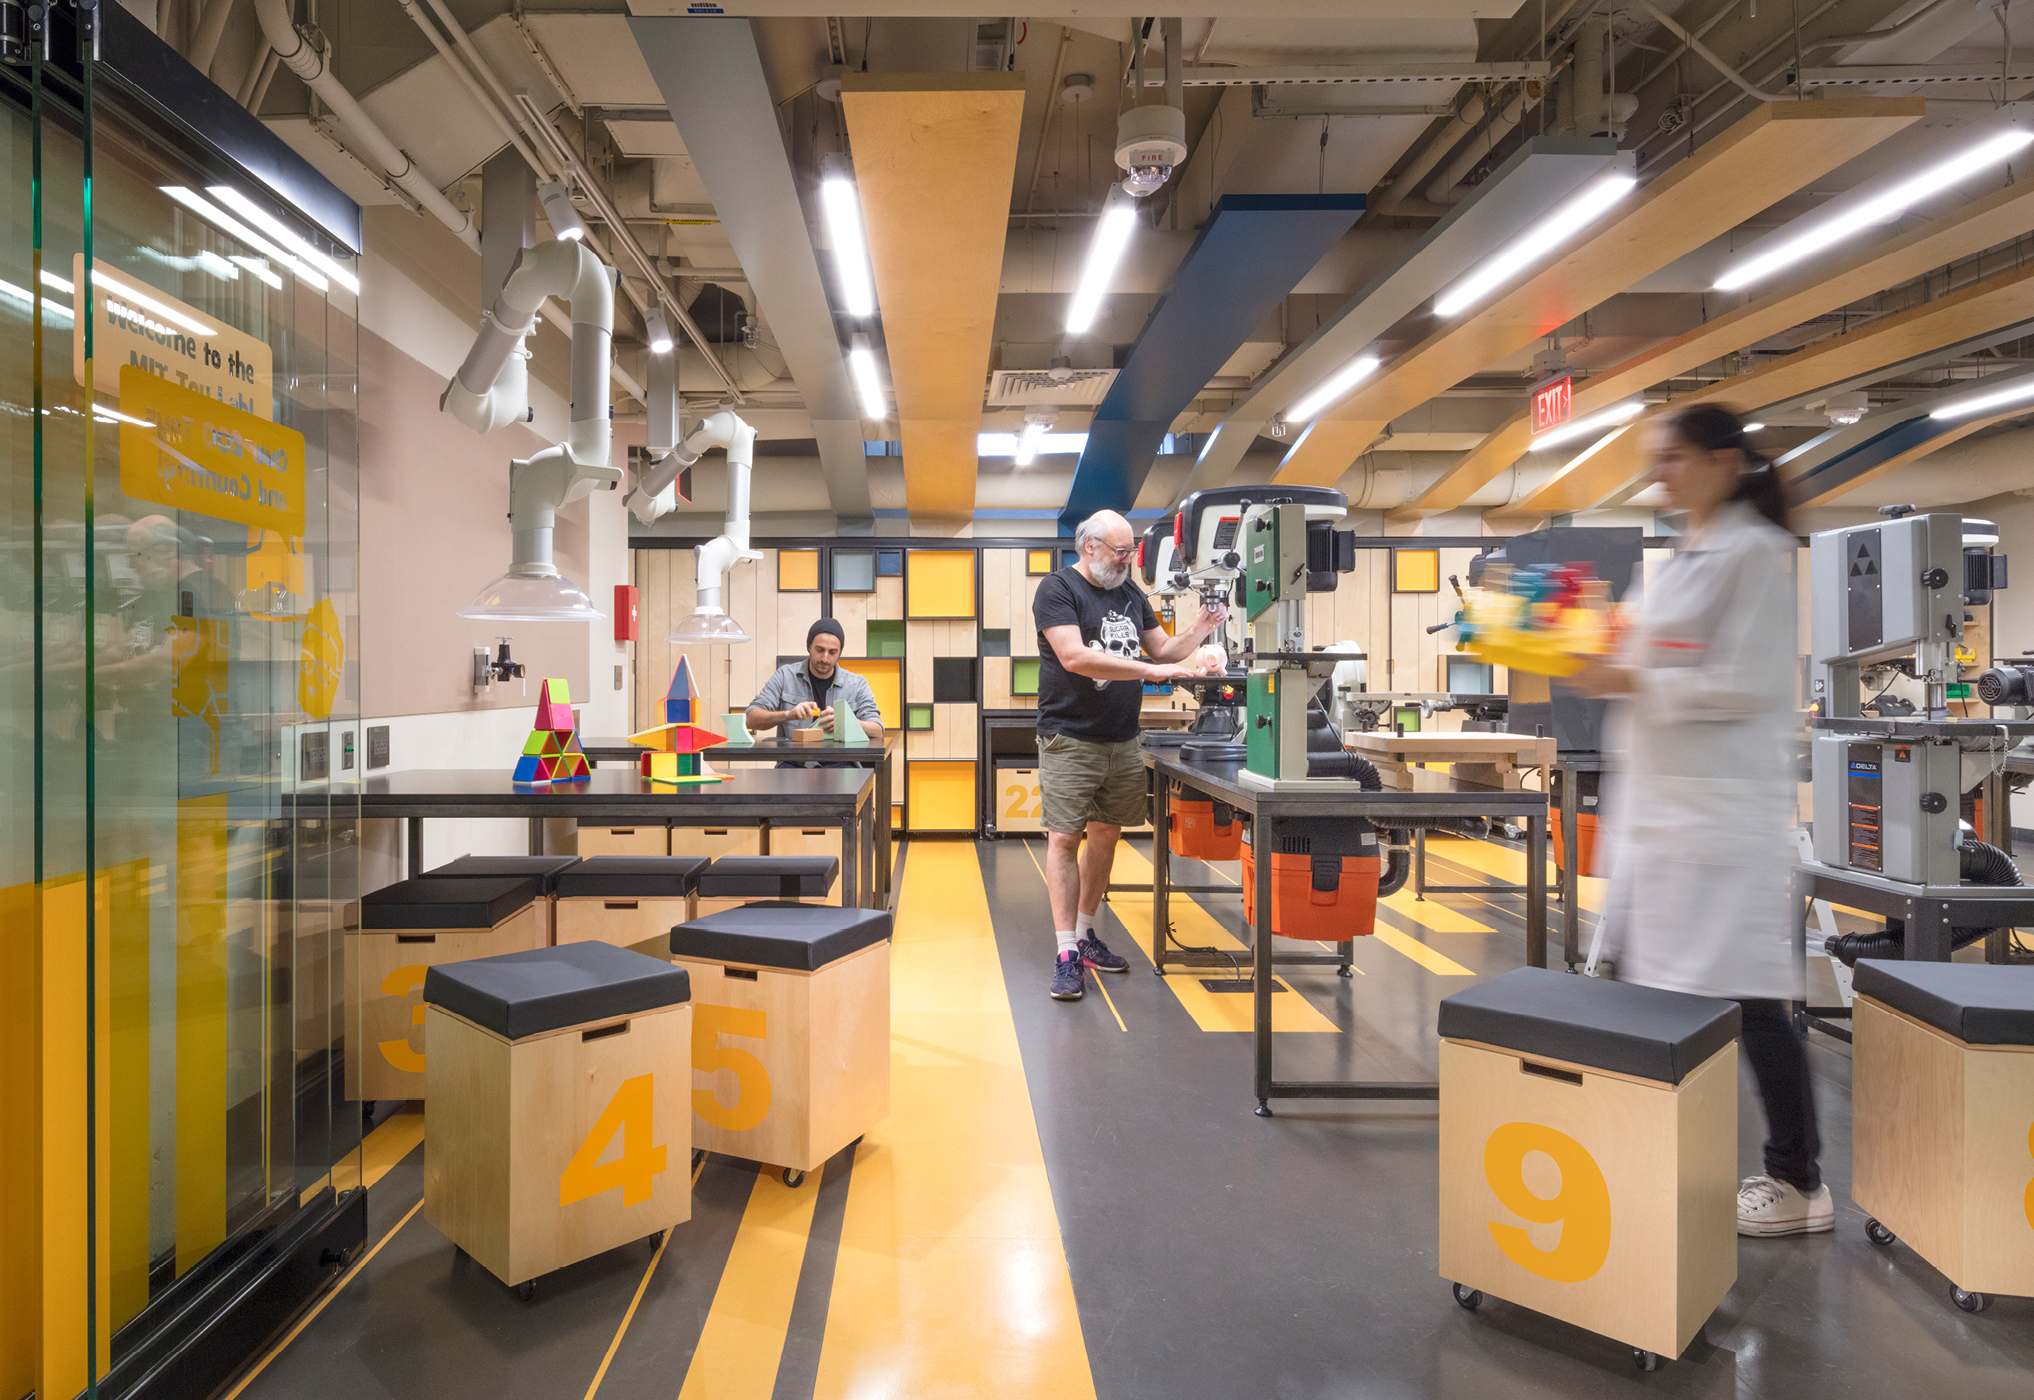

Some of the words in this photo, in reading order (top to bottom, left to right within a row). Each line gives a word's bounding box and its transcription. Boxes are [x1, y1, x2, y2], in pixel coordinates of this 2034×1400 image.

[106, 294, 196, 360] Welcome
[203, 342, 222, 370] to
[228, 350, 254, 385] the
[1537, 385, 1563, 427] EXIT
[691, 1002, 772, 1131] 5
[560, 1072, 667, 1209] 4
[1484, 1122, 1611, 1283] 9
